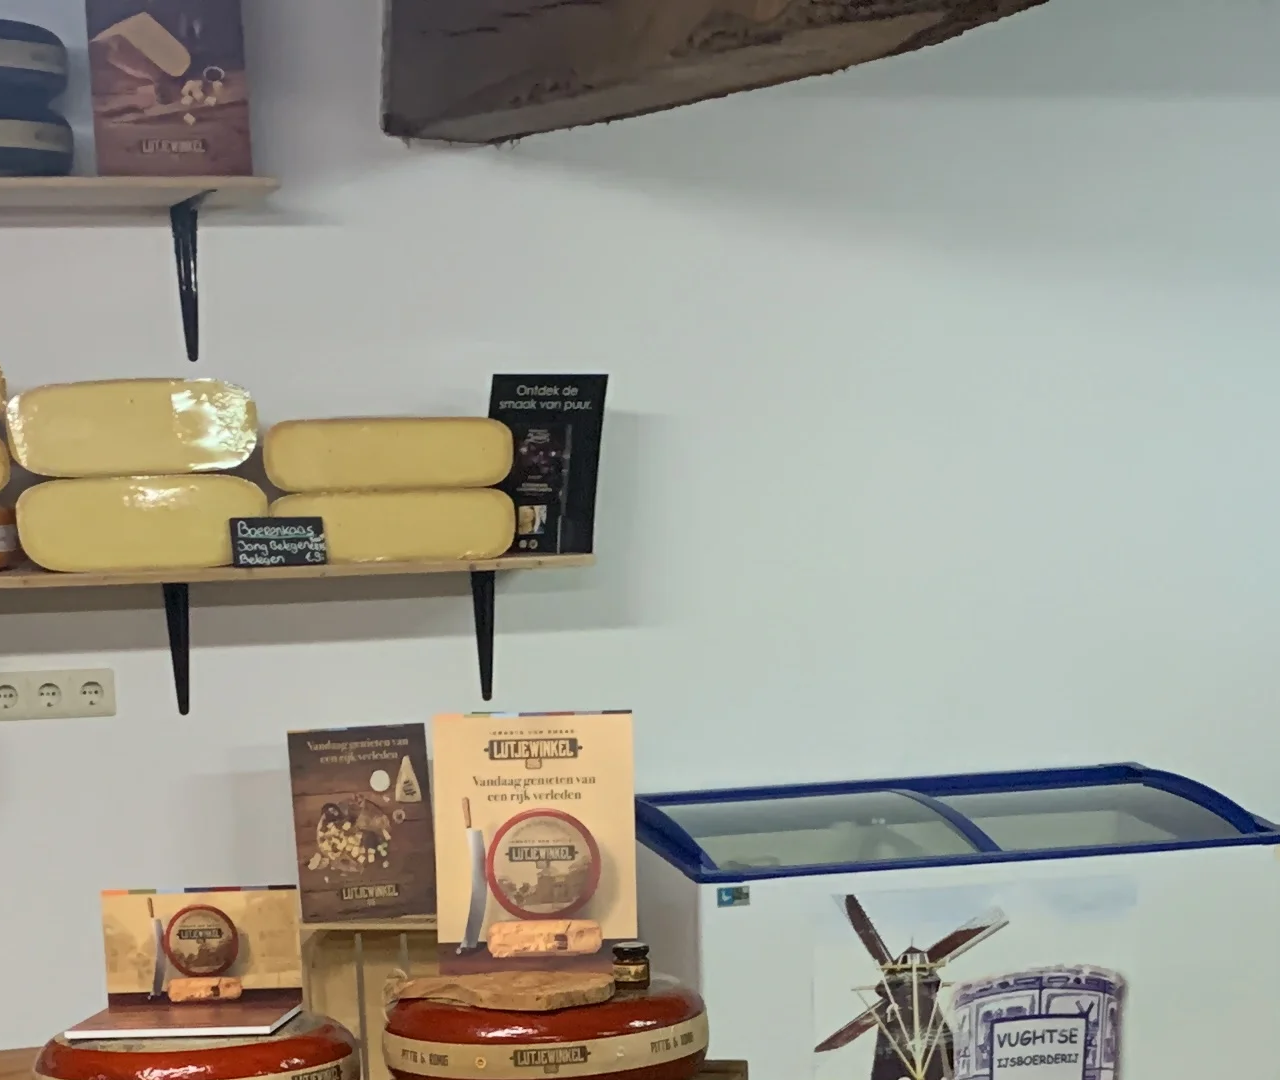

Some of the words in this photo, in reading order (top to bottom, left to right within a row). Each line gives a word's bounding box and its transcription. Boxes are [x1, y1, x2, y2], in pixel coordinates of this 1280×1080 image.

[516, 384, 560, 396] Ontdek
[562, 384, 579, 396] de
[499, 399, 537, 410] smaak
[540, 401, 562, 410] van
[493, 738, 574, 759] LUTJEWINKEL
[472, 775, 522, 789] Vandaag
[523, 775, 574, 789] genieten
[576, 775, 596, 785] van
[487, 793, 508, 802] een
[510, 789, 531, 804] rijk
[533, 788, 582, 800] verleden
[511, 846, 573, 861] LUTJEWINKEL
[996, 1027, 1079, 1049] VUGHTSE
[516, 1047, 585, 1066] LUTJEWINKEL
[996, 1053, 1079, 1068] IJSBOERDERIJ
